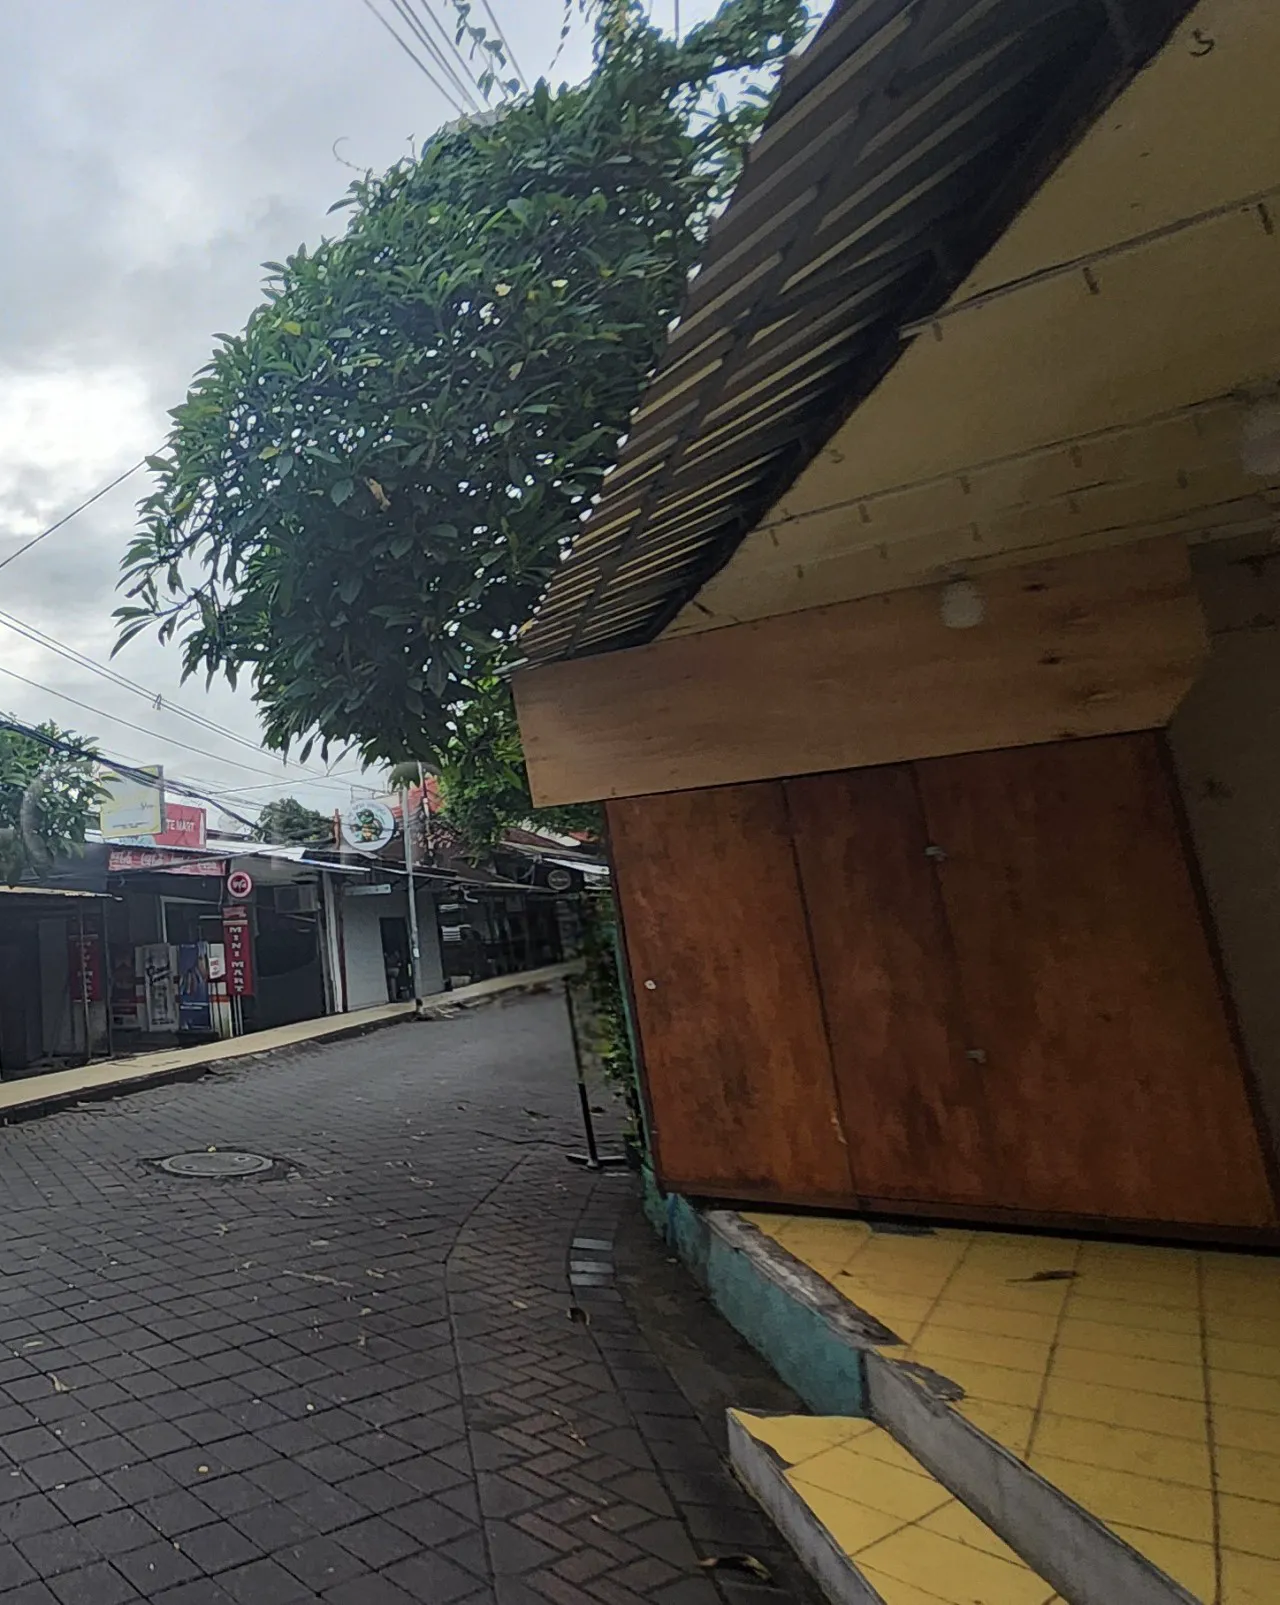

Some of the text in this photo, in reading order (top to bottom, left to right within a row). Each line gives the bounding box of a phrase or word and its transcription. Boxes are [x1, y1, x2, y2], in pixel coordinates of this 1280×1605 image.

[176, 819, 196, 833] MART
[229, 926, 243, 958] MINI
[231, 960, 245, 993] MART
